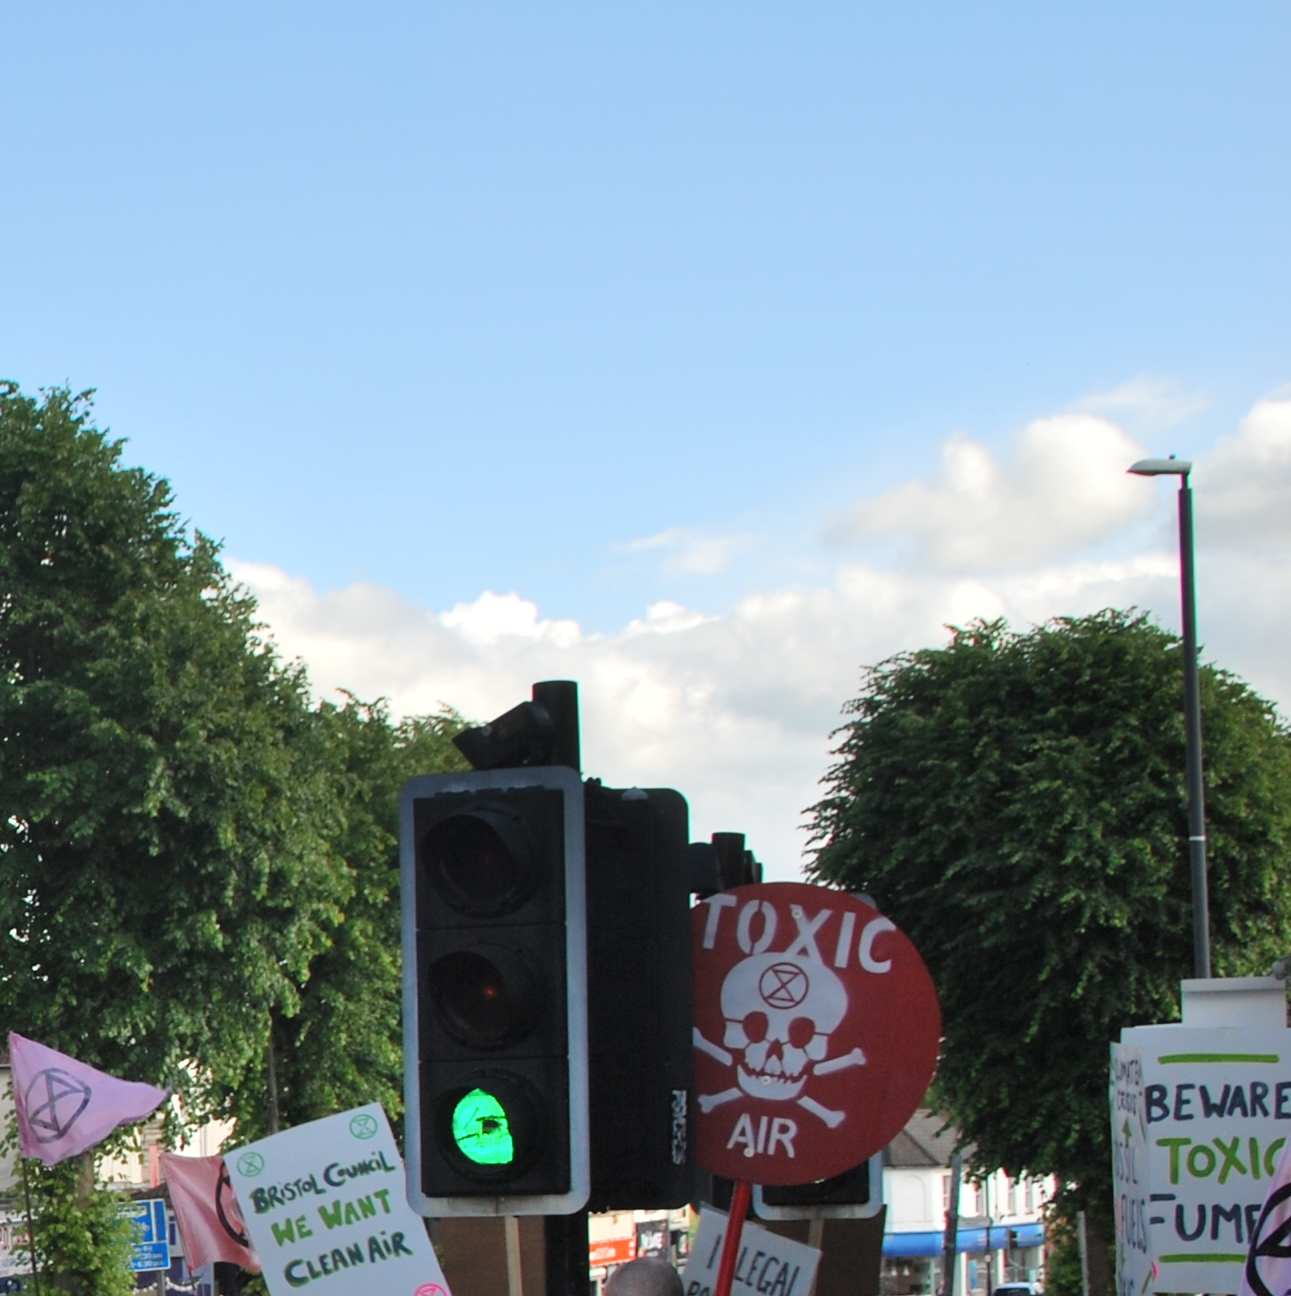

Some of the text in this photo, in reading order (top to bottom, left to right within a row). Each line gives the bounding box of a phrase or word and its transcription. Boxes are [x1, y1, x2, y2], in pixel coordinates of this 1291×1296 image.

[702, 893, 897, 973] TOXIC
[1144, 1081, 1291, 1124] BEWARE
[726, 1112, 798, 1159] AIR
[271, 1188, 391, 1247] WE WANT
[284, 1243, 365, 1288] CLEAN
